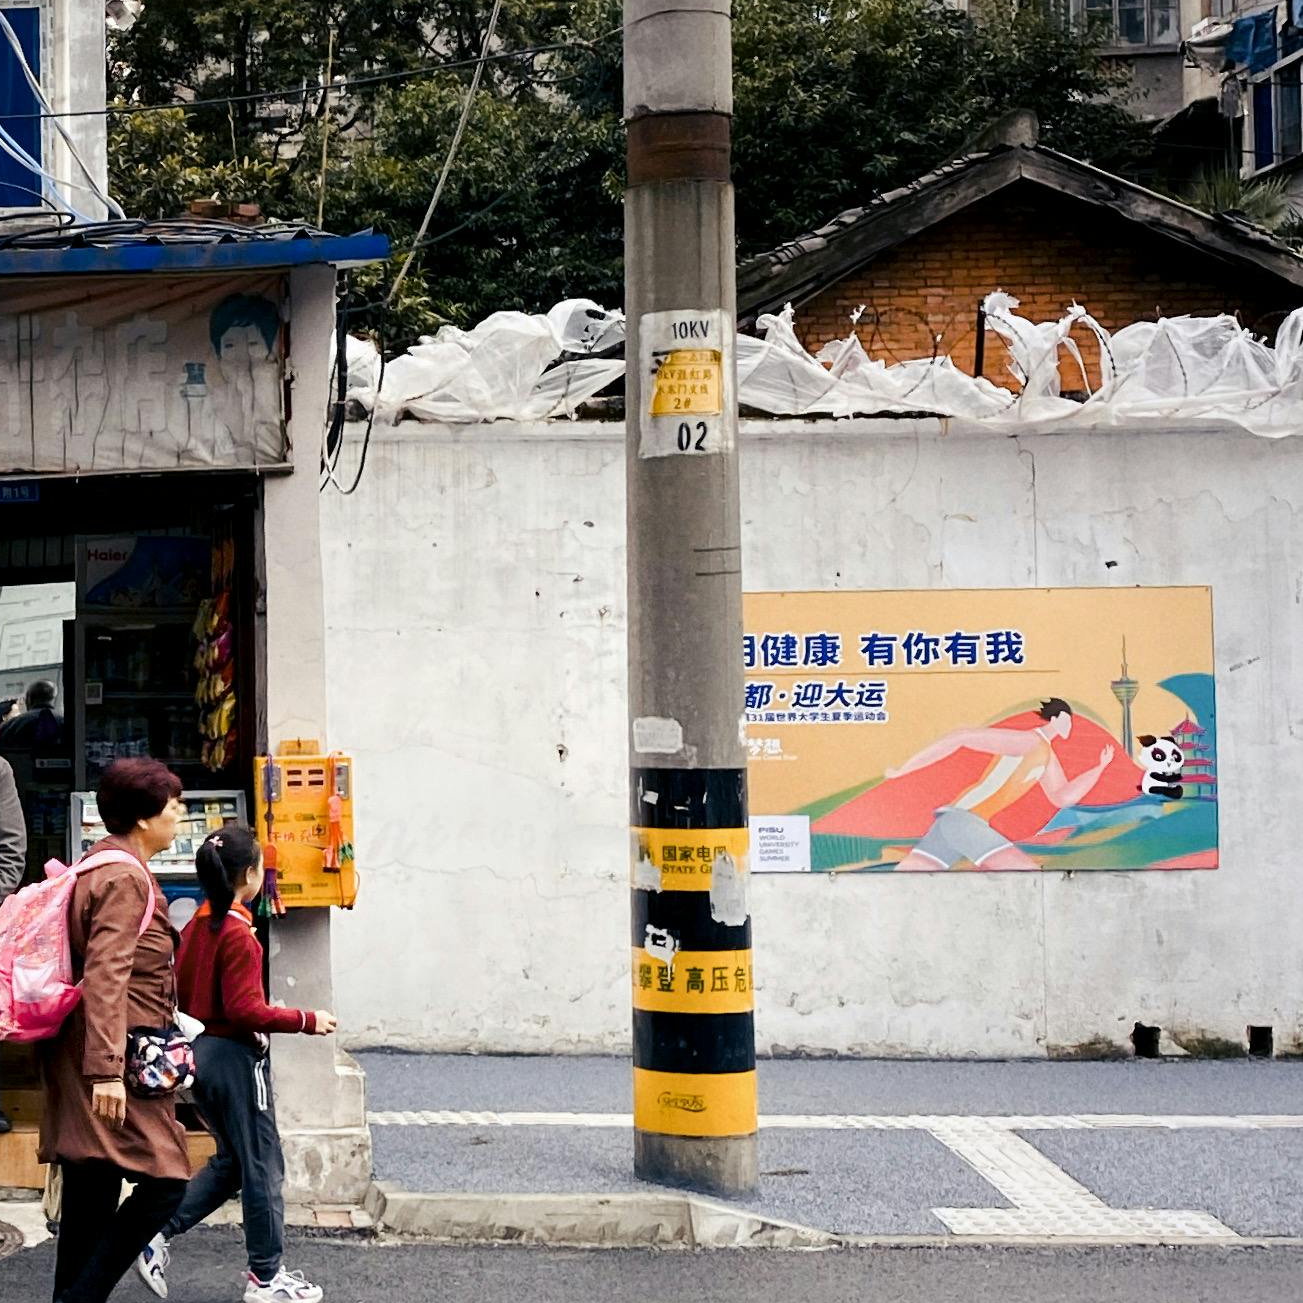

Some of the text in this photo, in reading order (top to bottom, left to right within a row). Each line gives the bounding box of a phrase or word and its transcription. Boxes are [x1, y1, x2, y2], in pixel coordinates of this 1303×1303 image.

[672, 320, 709, 339] 10KV
[677, 421, 708, 452] 02
[87, 548, 127, 561] Haier
[861, 632, 1024, 666] 有你有我
